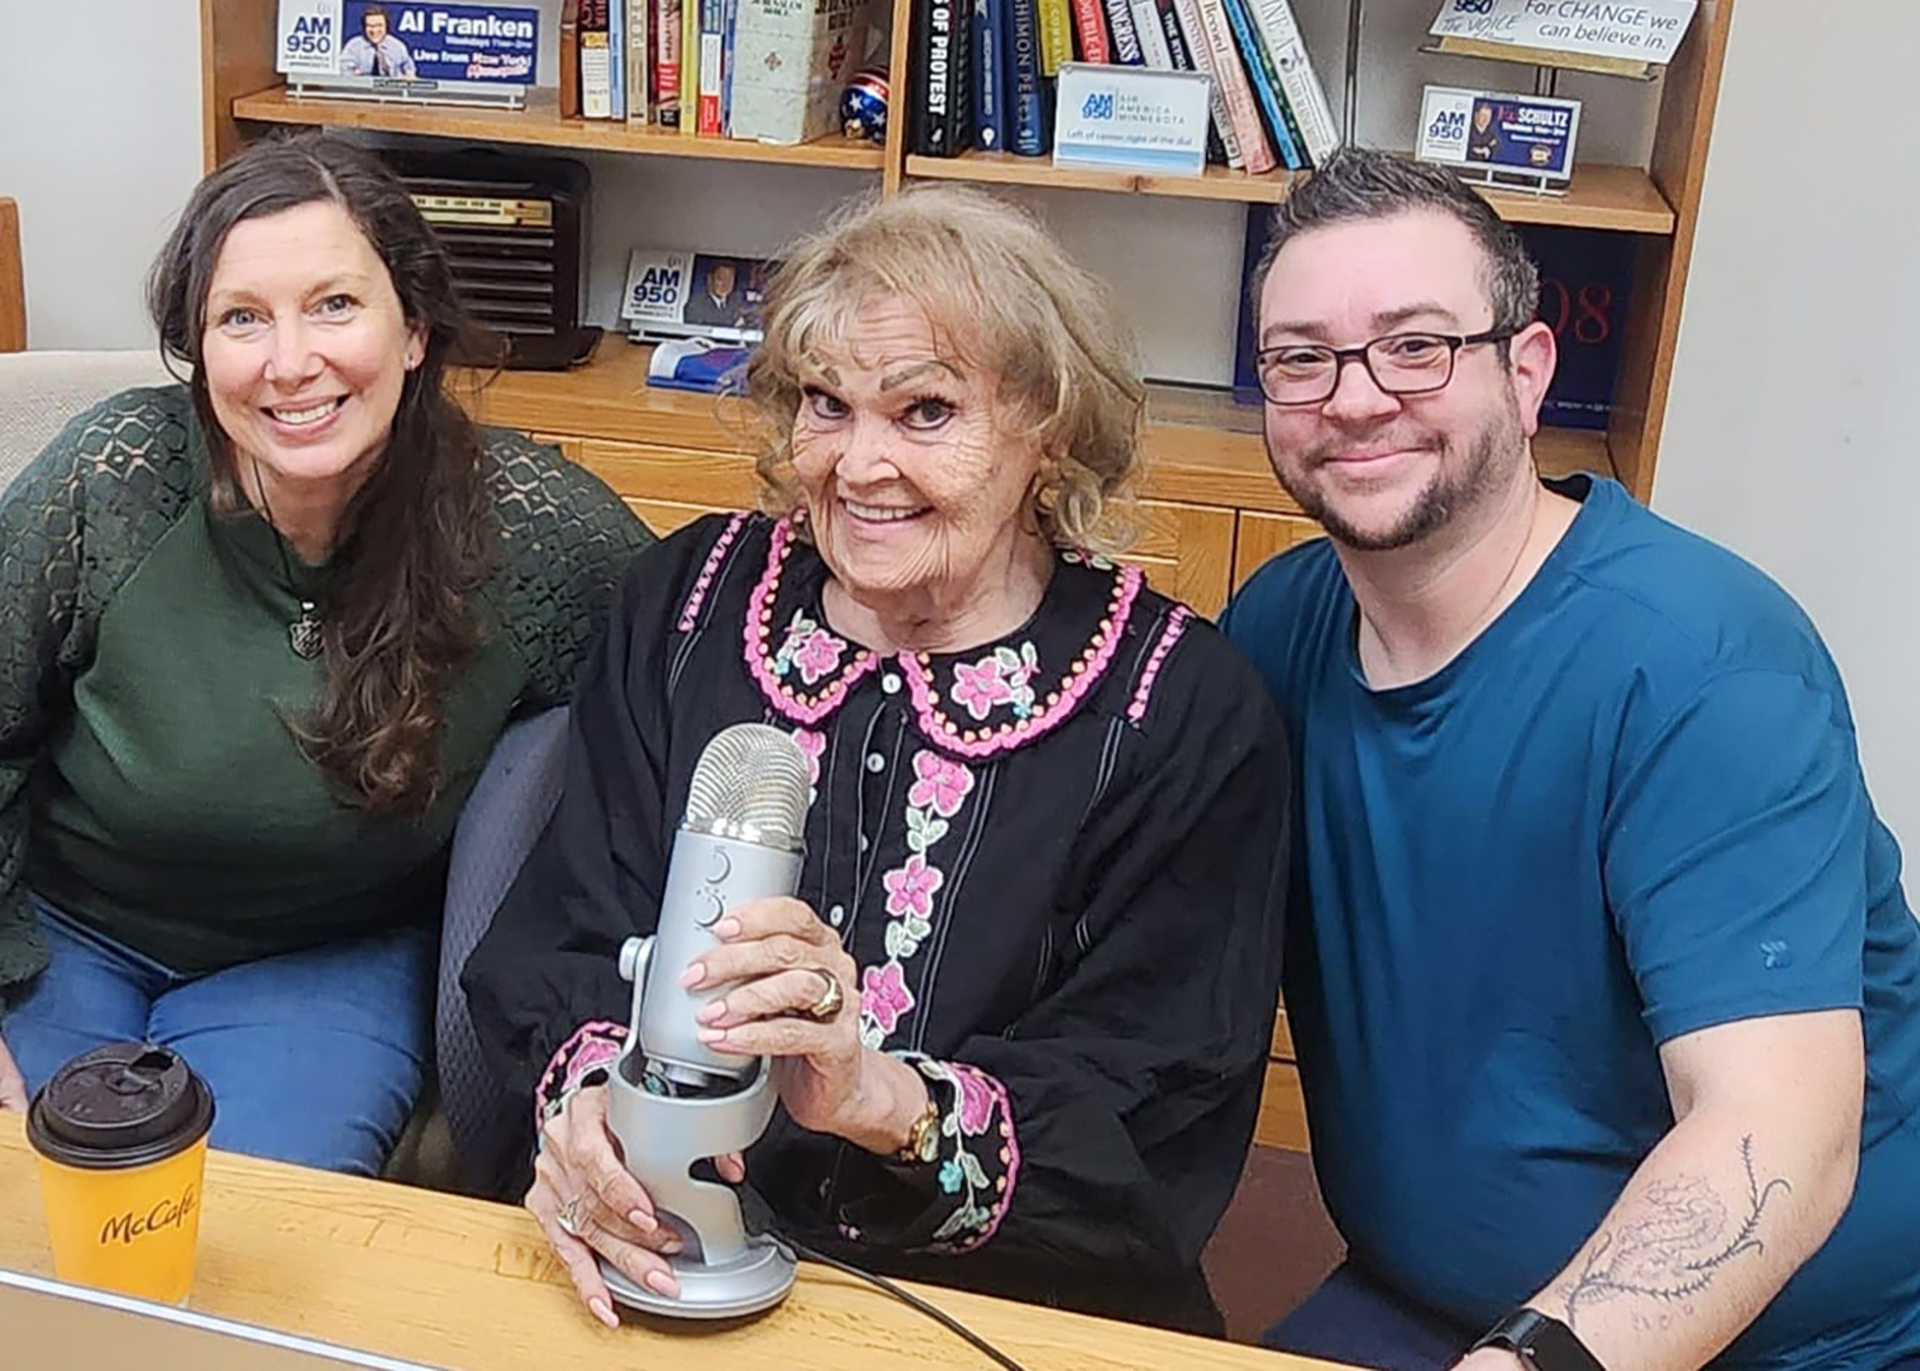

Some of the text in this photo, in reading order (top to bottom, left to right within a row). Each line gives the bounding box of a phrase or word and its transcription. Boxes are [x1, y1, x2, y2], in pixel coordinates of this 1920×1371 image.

[294, 16, 331, 35] AM
[399, 10, 533, 38] Al Franken
[932, 8, 950, 32] OF
[1525, 0, 1678, 31] For CHANGE we
[1204, 0, 1229, 52] Record
[286, 34, 331, 53] 950
[1538, 23, 1667, 50] can believe in.
[413, 49, 439, 61] Live
[928, 36, 949, 116] PROTEST
[1087, 93, 1113, 106] AM
[1082, 104, 1171, 119] 950 AMERICA
[1436, 111, 1466, 127] AM
[1519, 107, 1569, 127] SCHULTZ
[1428, 124, 1464, 140] 950
[642, 267, 680, 287] AM
[633, 284, 678, 304] 950
